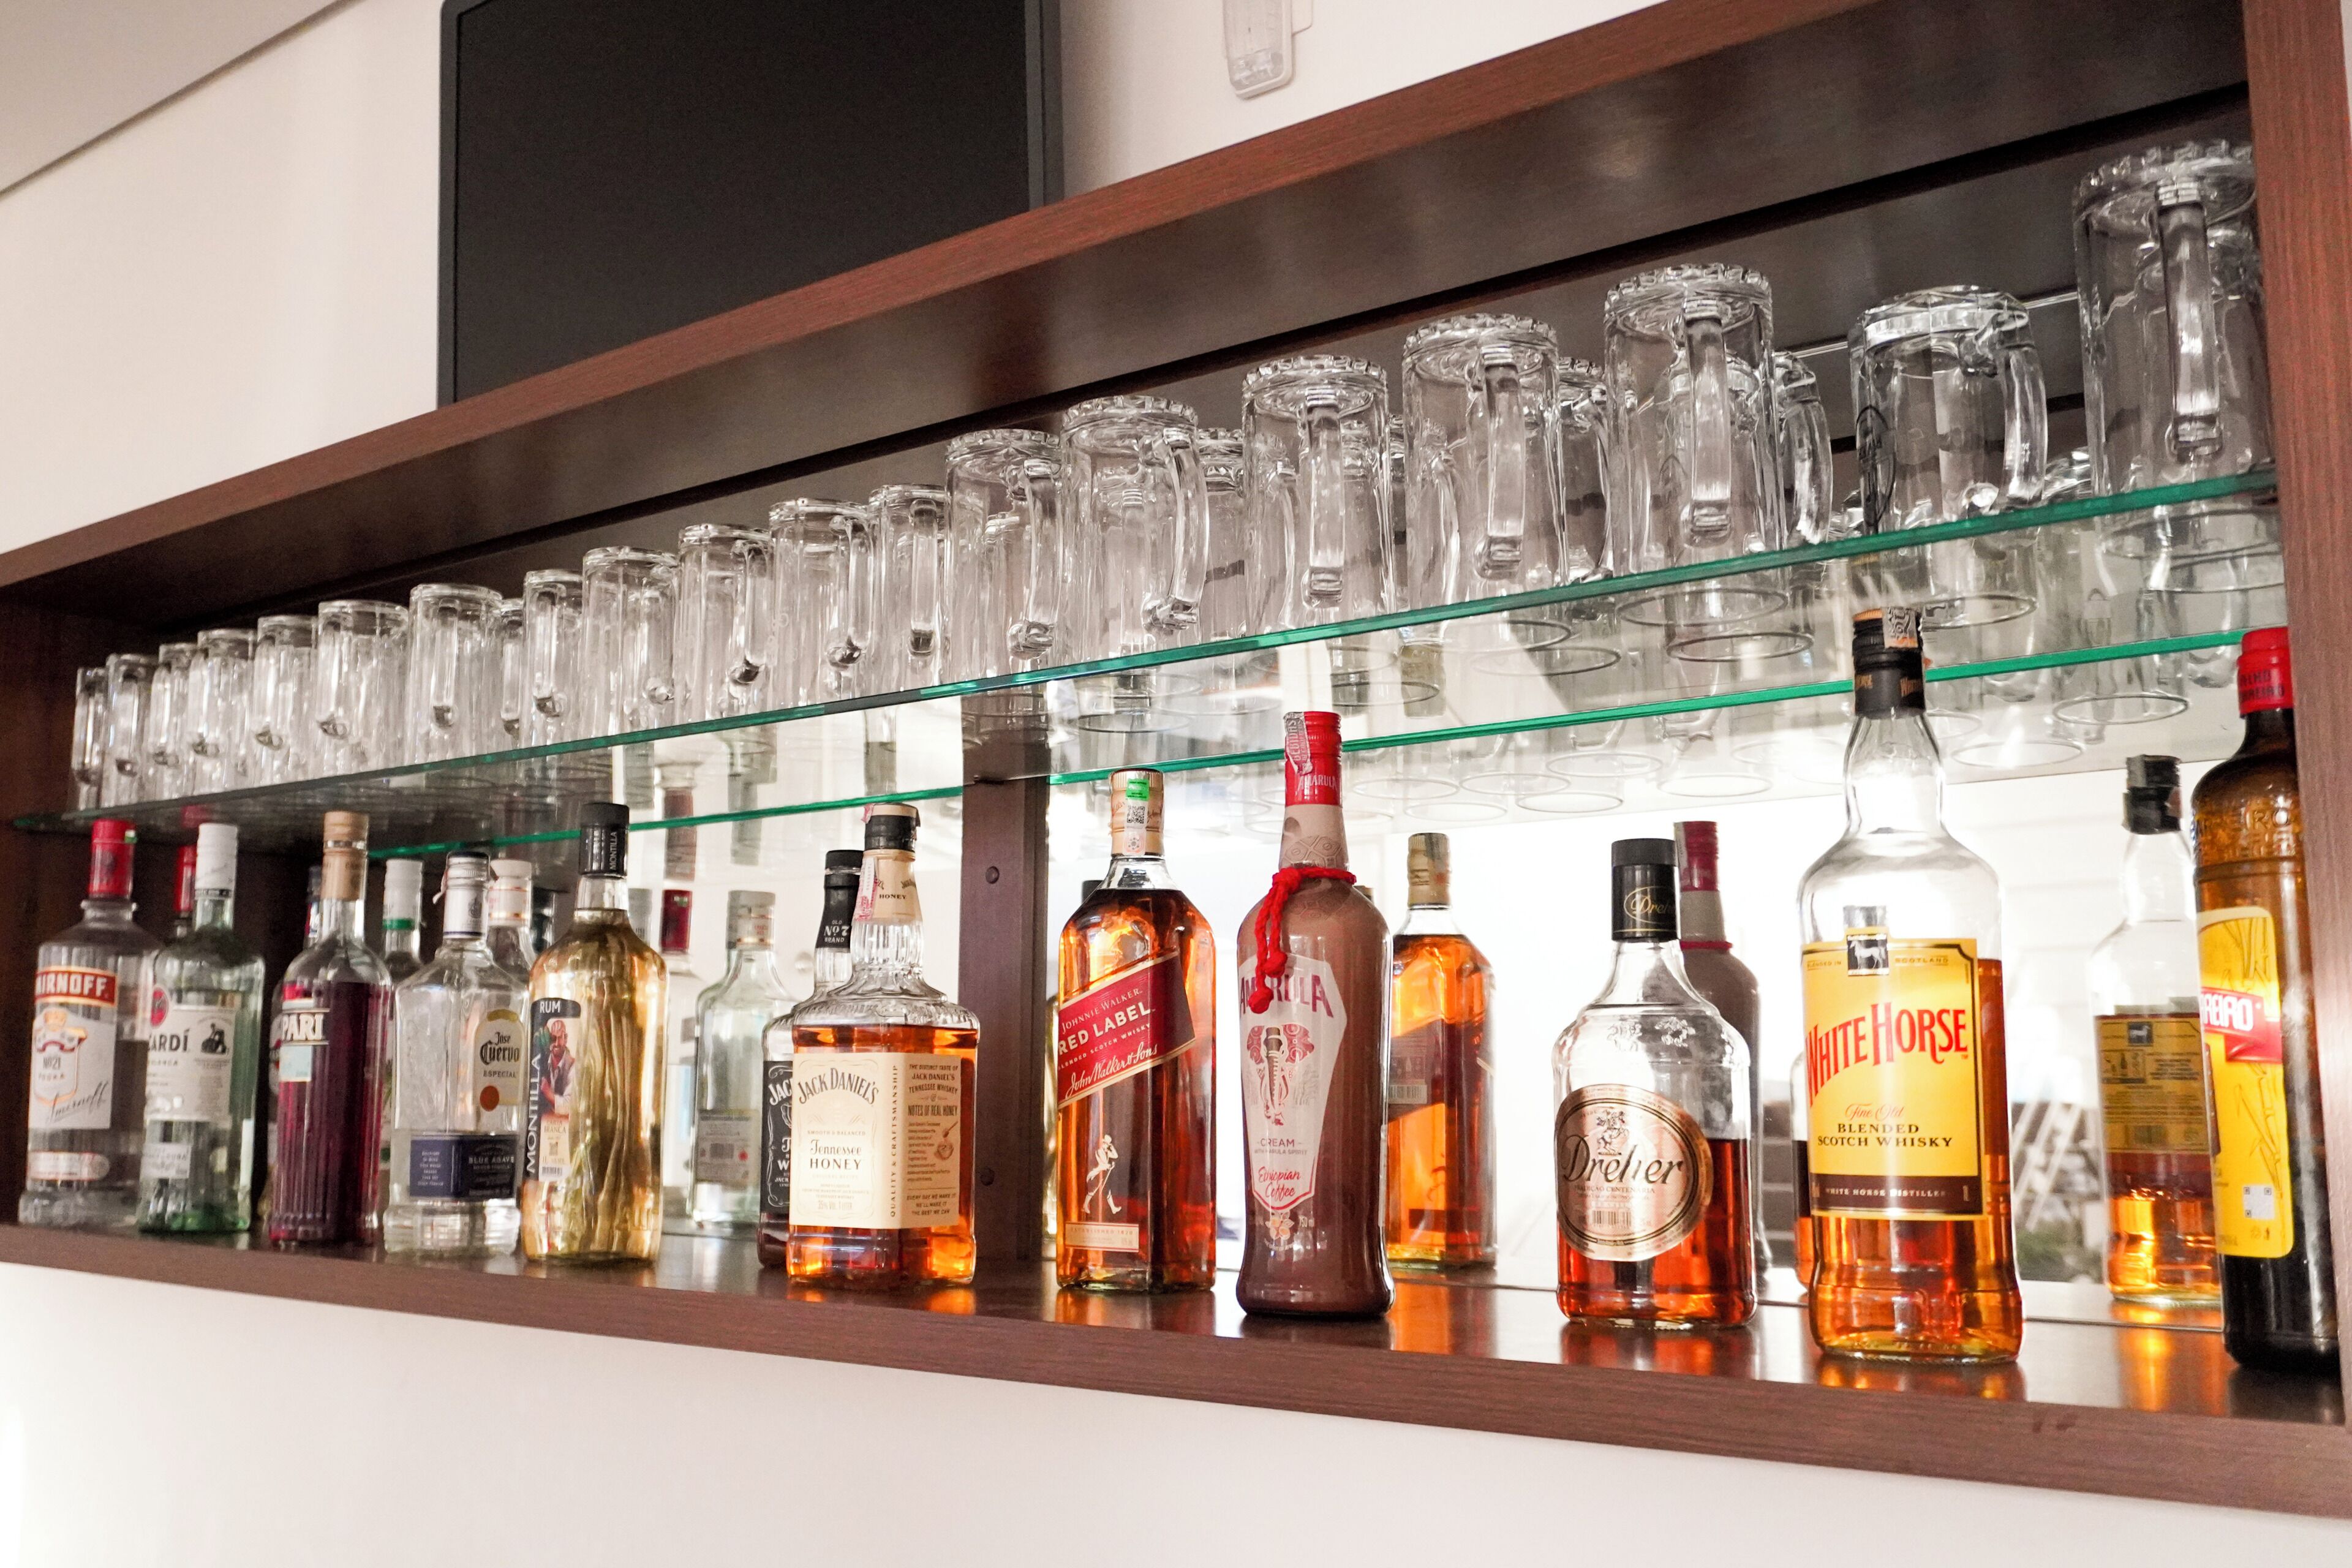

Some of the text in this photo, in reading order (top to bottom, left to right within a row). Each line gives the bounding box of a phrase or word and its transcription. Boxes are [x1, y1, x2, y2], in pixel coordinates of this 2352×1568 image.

[1297, 774, 1338, 792] AMARULA
[540, 1000, 561, 1014] RUM
[1061, 987, 1140, 1035] JOHNNIE WALKER
[1058, 1001, 1152, 1056] RED LABEL
[480, 1039, 520, 1066] Cuervo
[1058, 1022, 1151, 1071] BLENDED SCOTCH WHISKY
[1805, 1001, 1969, 1108] WHITE HORSE
[483, 1069, 517, 1078] ESPECIAL
[1065, 1069, 1093, 1100] John
[1090, 1055, 1128, 1082] Walker
[1131, 1041, 1158, 1065] Sons
[768, 1078, 793, 1106] JAC
[797, 1068, 880, 1105] JACK DANIEL'S
[908, 1083, 958, 1095] TENNESSEE WHISKEY
[526, 1052, 541, 1174] MONTILLA
[908, 1104, 924, 1117] NOTES
[943, 1104, 958, 1117] HONEY
[1844, 1102, 1905, 1122] Fine Old
[1837, 1123, 1920, 1134] BLENDED
[810, 1139, 862, 1156] Tennessee
[1260, 1138, 1295, 1147] CREAM
[1817, 1136, 1953, 1148] SCOTCH WHISKY
[810, 1158, 862, 1170] HONEY
[1562, 1134, 1684, 1184] Dreher
[1257, 1166, 1302, 1185] Ethiopian
[1265, 1182, 1296, 1202] Coffee
[1853, 1188, 1886, 1196] HORSE
